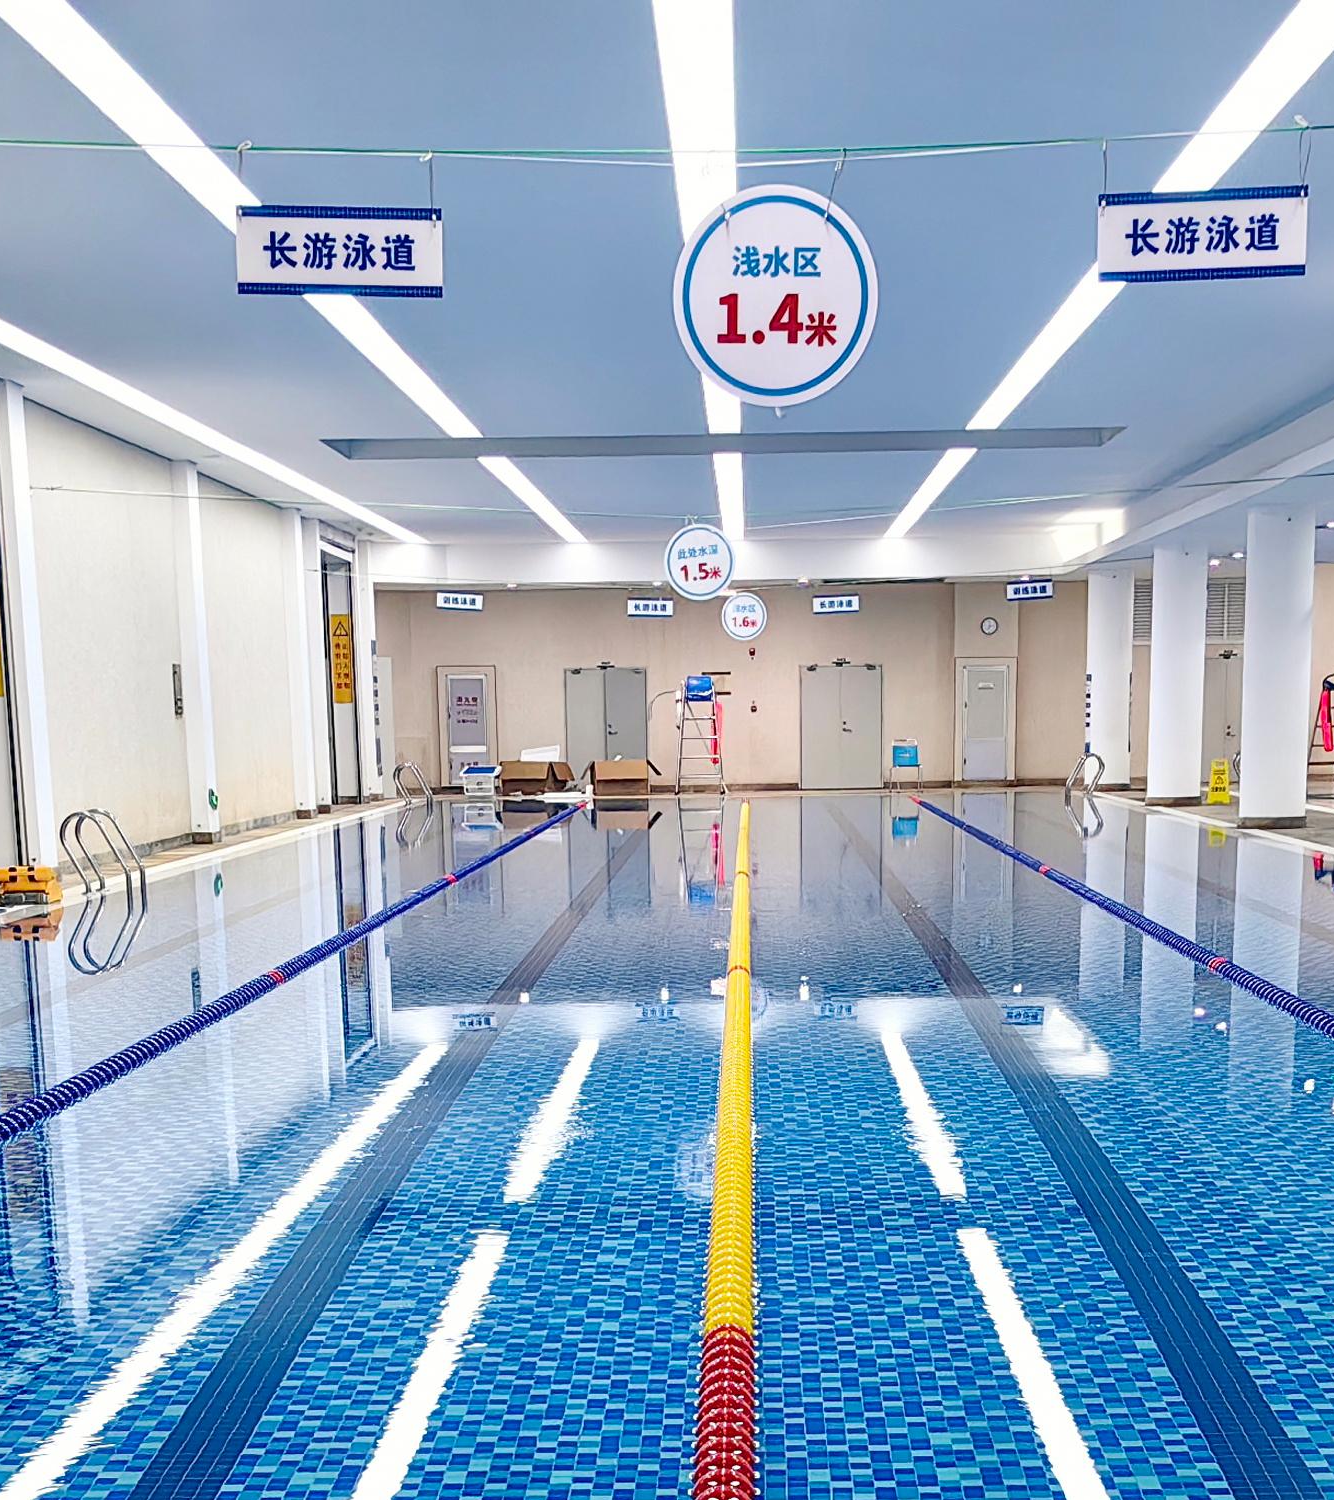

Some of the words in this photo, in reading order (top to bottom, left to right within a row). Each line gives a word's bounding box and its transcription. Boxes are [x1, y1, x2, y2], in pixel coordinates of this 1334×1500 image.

[263, 231, 416, 271] 长游泳道
[1125, 213, 1280, 257] 长游泳道
[732, 245, 822, 278] 浅水区
[717, 293, 837, 347] 1.4米
[680, 563, 722, 582] 1.5米
[732, 616, 758, 628] 1.6米
